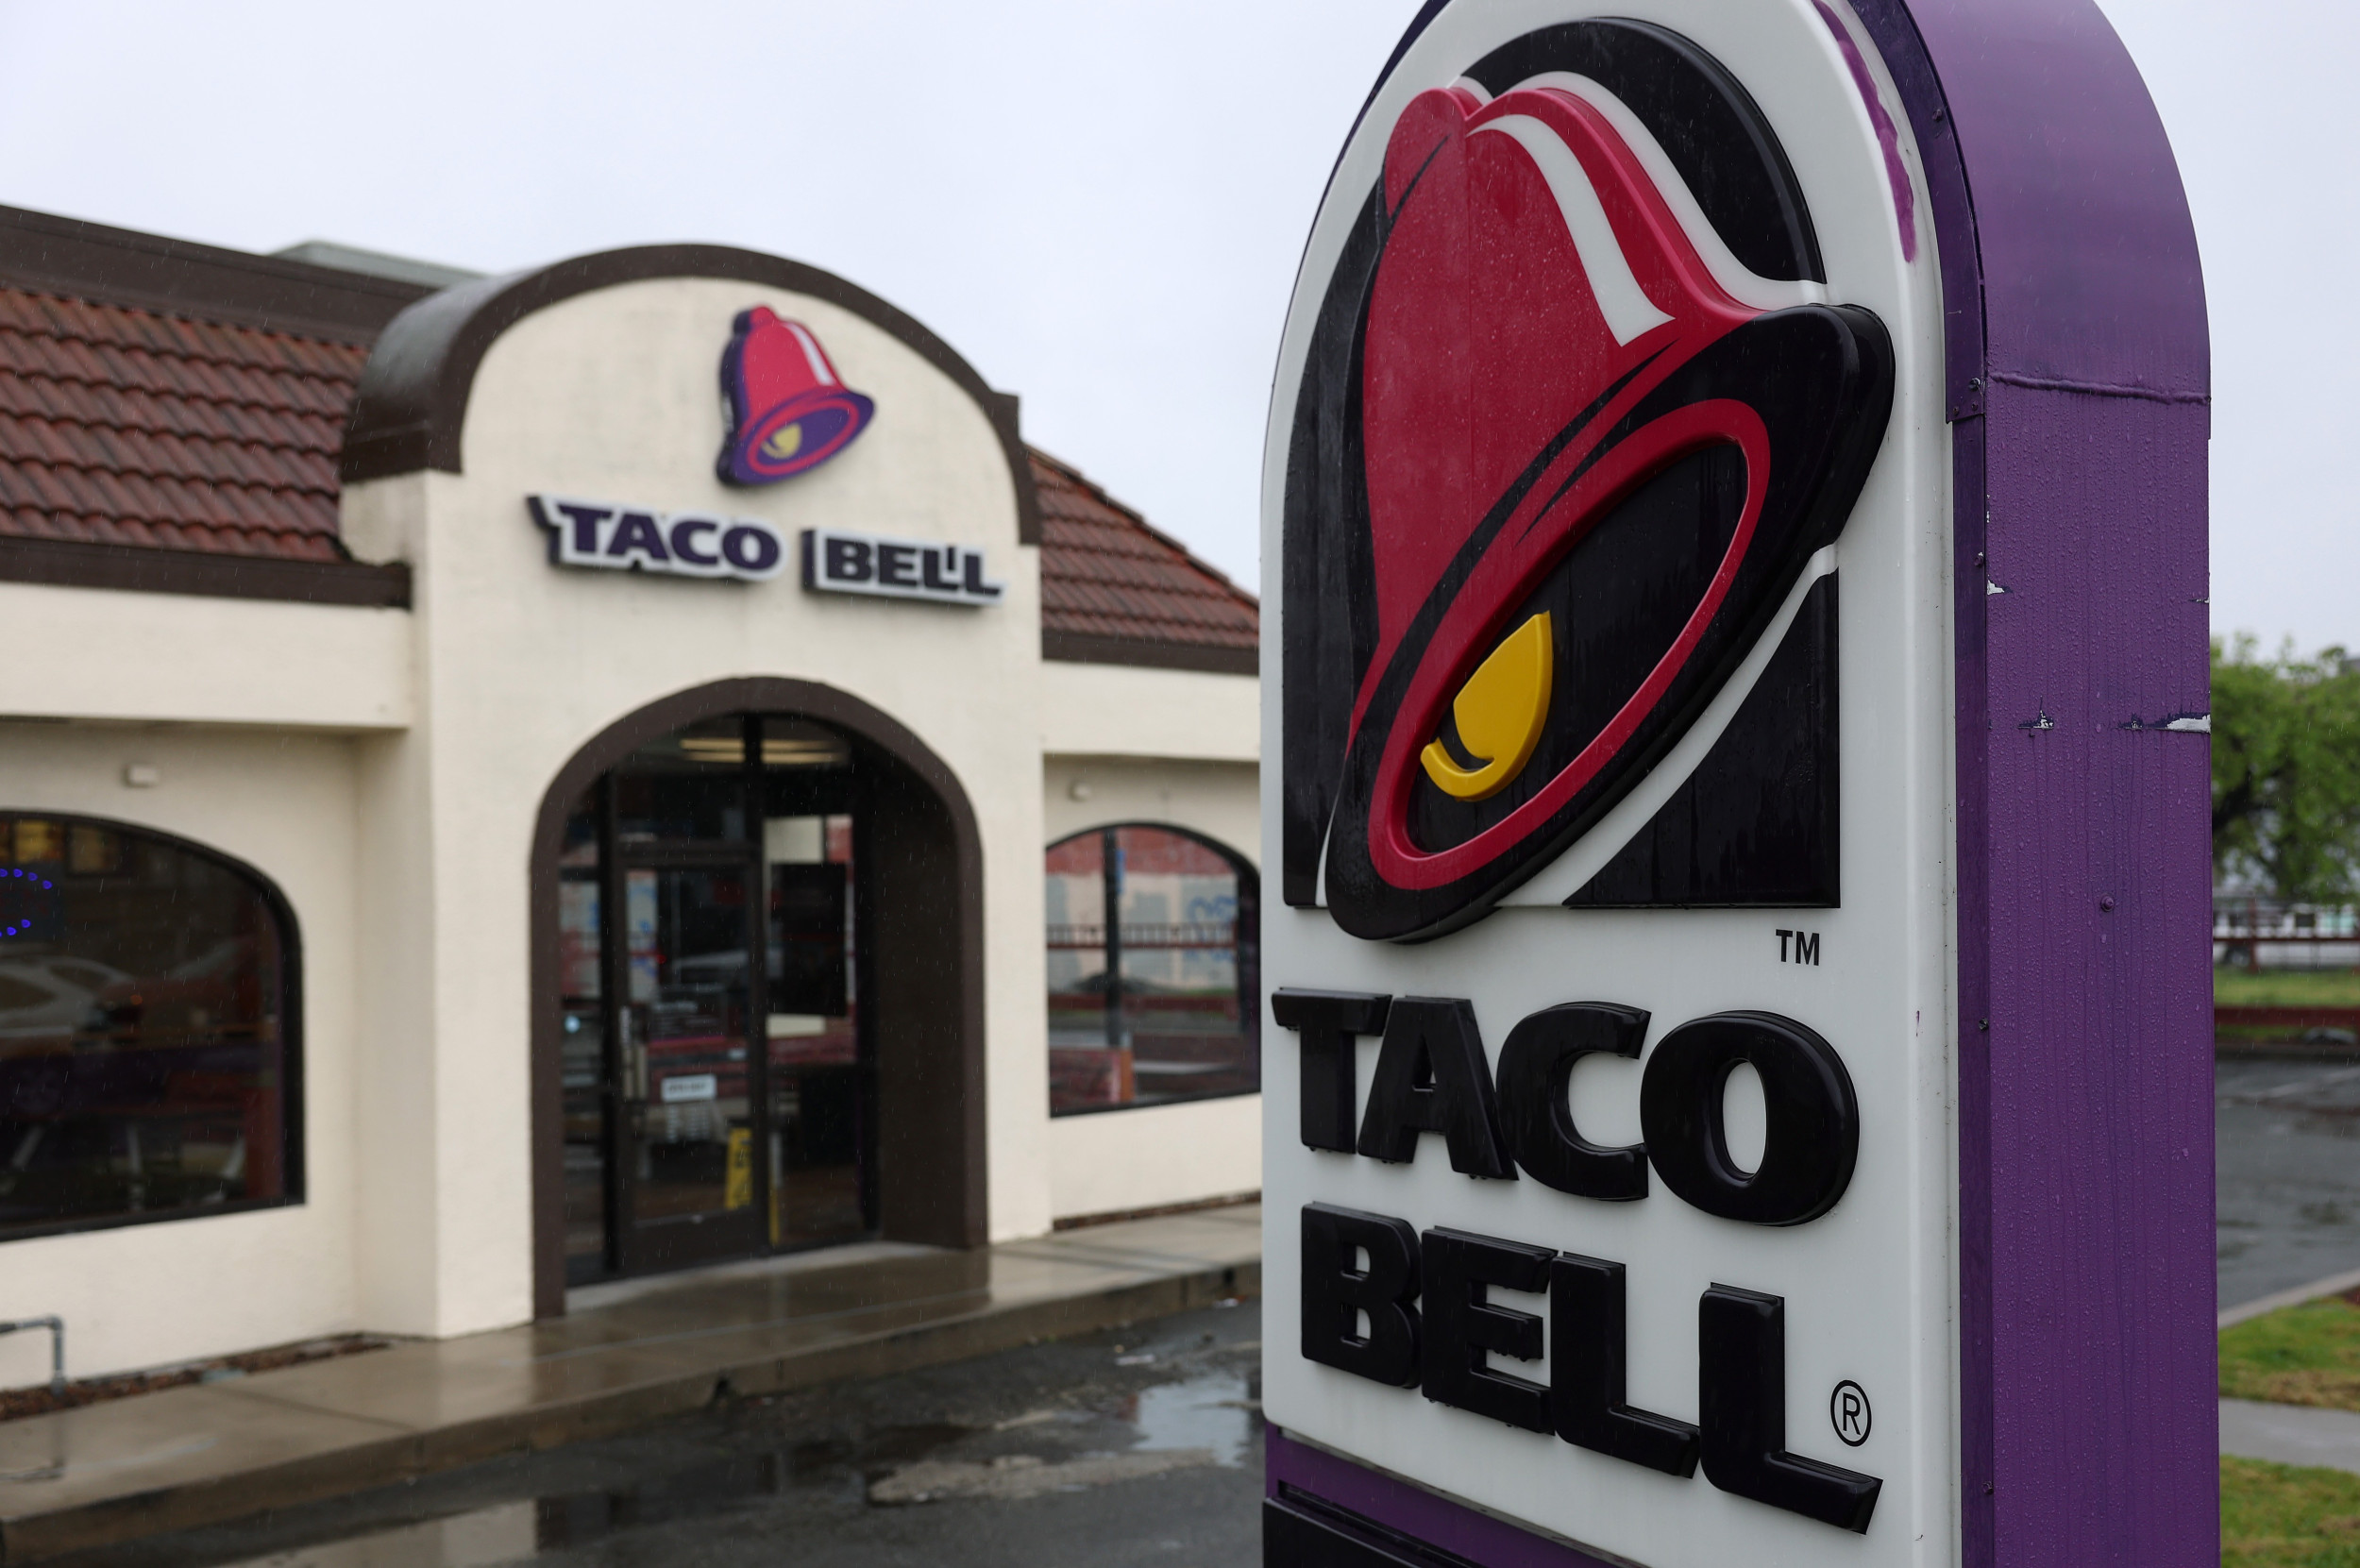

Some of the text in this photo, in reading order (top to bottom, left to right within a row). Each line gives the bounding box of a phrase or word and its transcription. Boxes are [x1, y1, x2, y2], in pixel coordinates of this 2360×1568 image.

[557, 502, 1003, 597] TACO BELL
[1775, 929, 1820, 966] TM
[1272, 986, 1861, 1227] TACO
[1300, 1200, 1884, 1536] BELL
